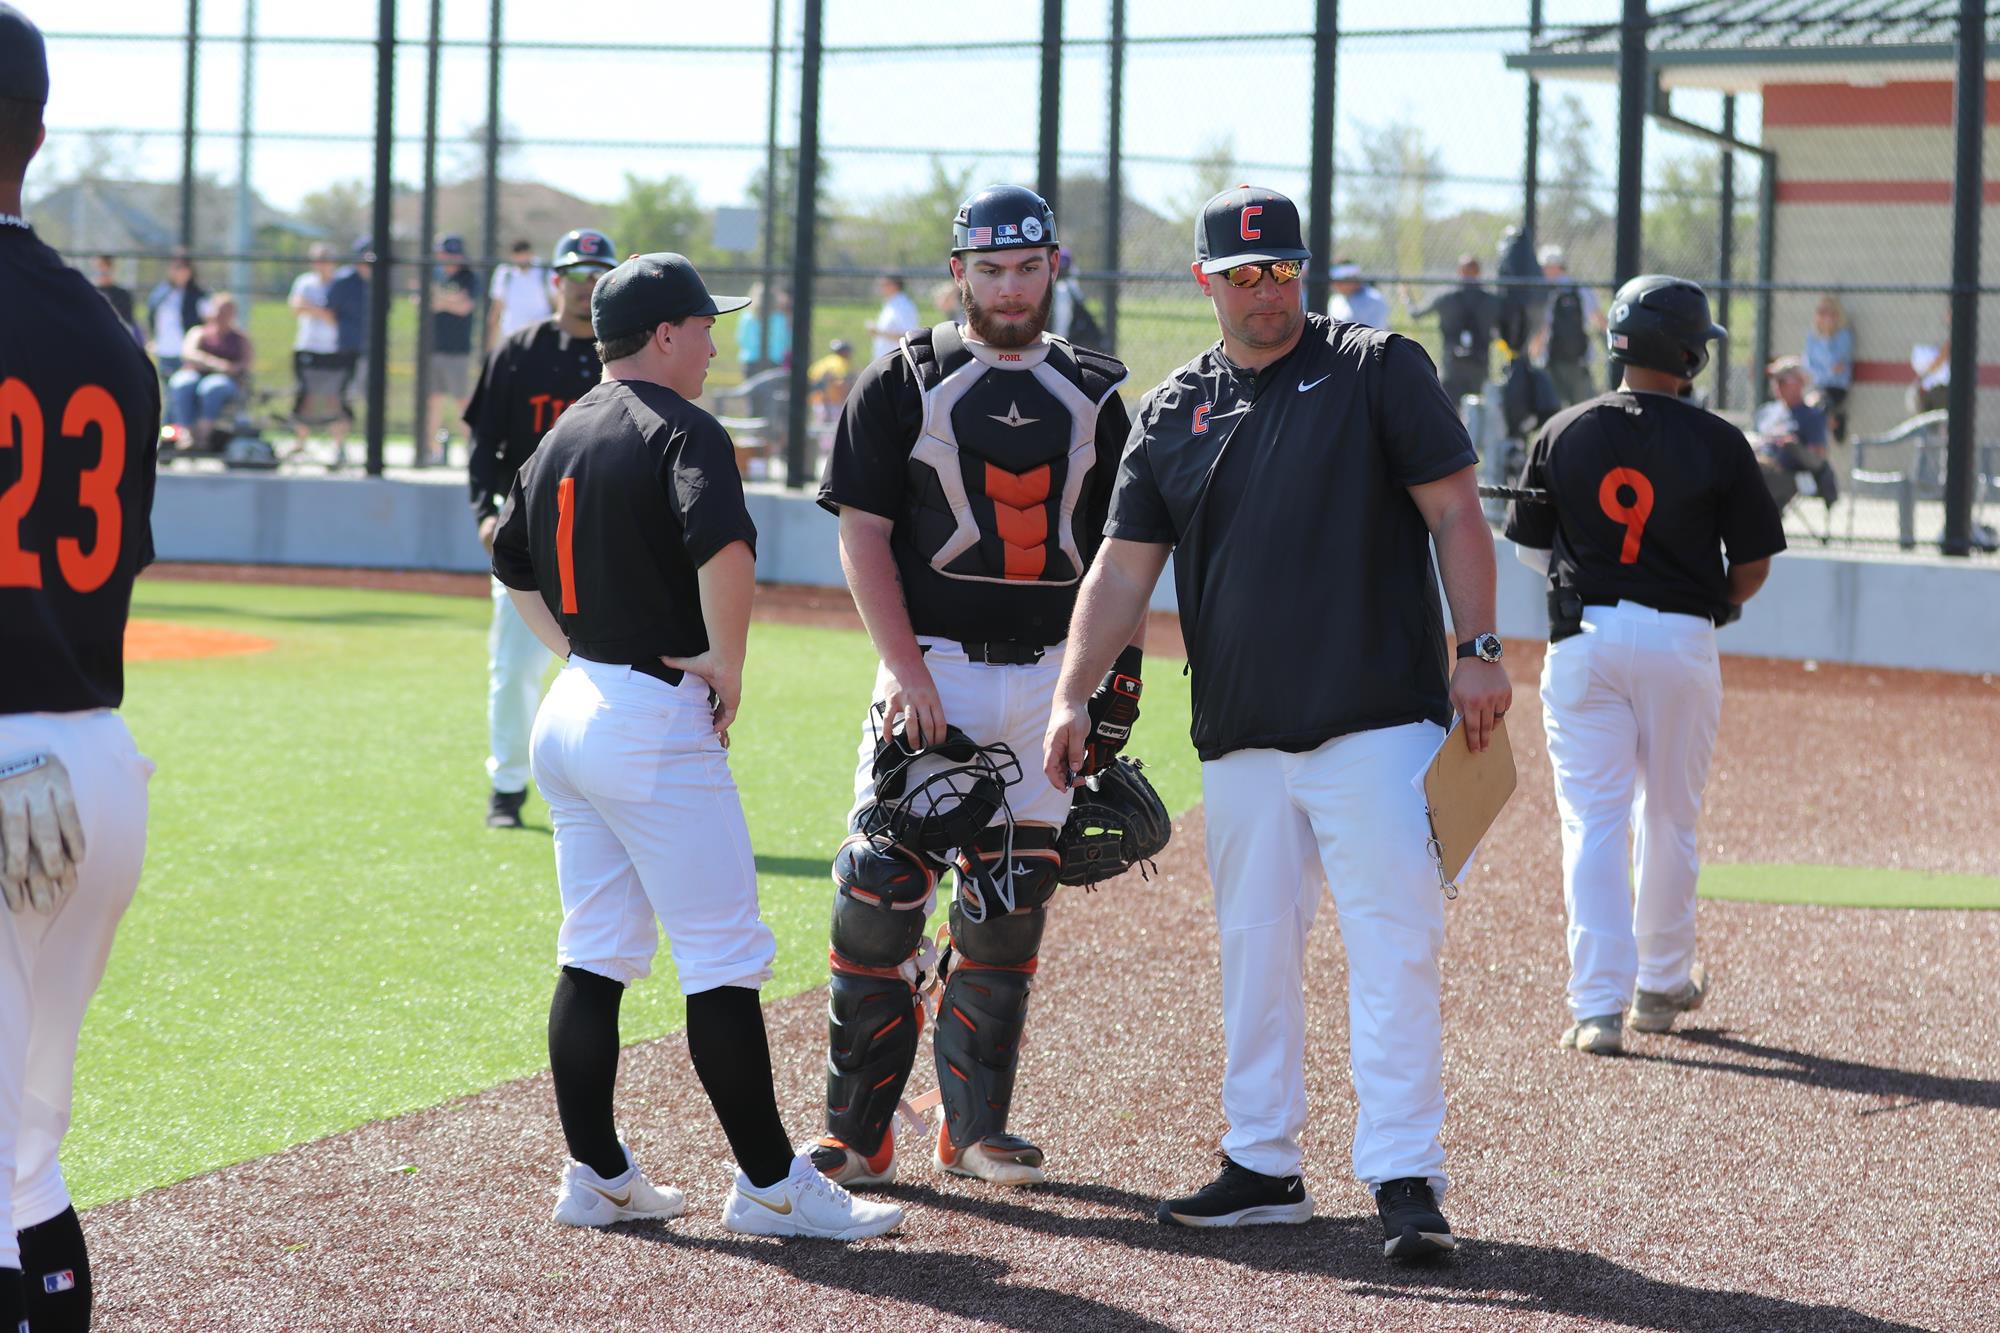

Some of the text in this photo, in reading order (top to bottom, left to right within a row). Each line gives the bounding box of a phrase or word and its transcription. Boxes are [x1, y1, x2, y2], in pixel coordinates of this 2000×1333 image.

[995, 236, 1022, 245] Wilson
[1240, 205, 1263, 241] C
[1192, 402, 1211, 436] C
[0, 376, 126, 593] 23
[1599, 466, 1654, 564] 9
[556, 477, 578, 614] 1
